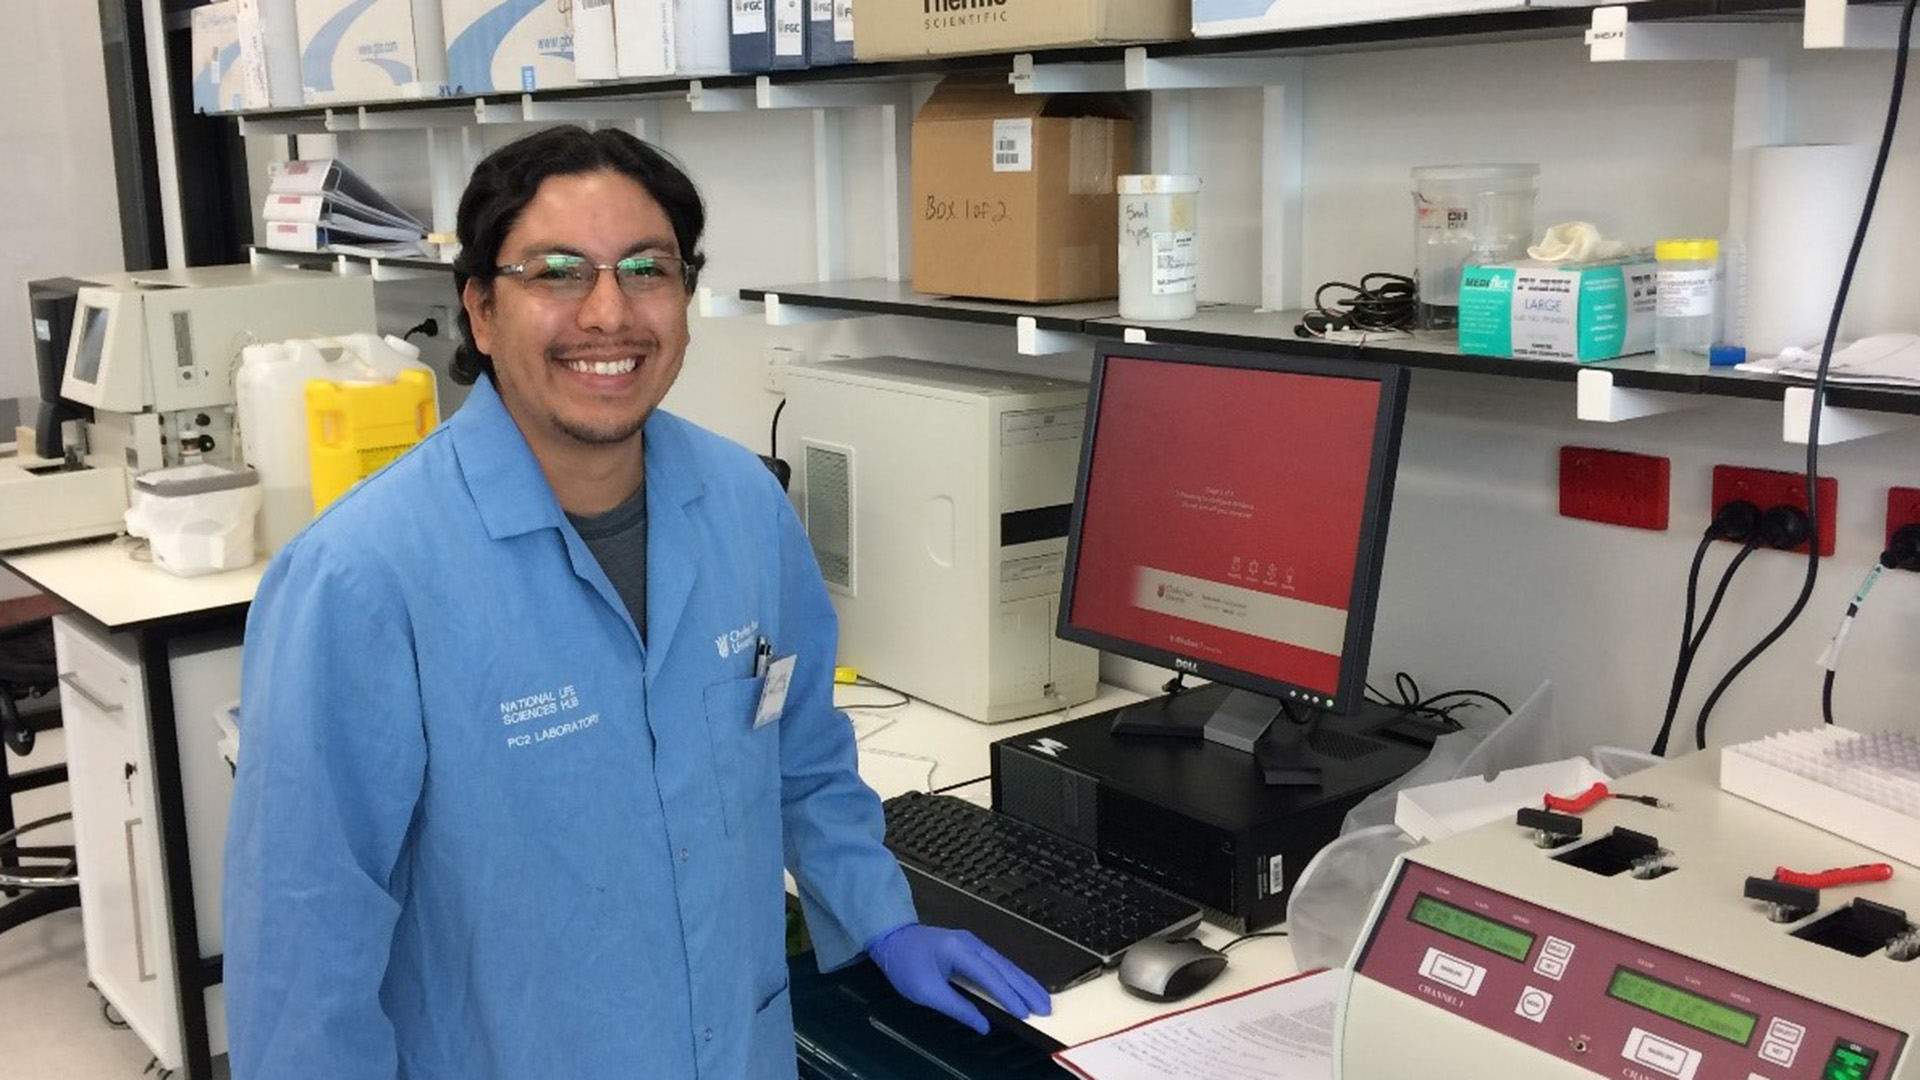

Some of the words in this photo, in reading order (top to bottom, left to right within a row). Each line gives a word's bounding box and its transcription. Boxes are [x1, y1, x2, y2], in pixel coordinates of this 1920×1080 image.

[743, 1, 763, 12] FGC
[784, 23, 801, 33] FGC
[924, 11, 1007, 30] SCIENTIFIC
[926, 194, 956, 221] Box
[974, 202, 990, 219] of
[1524, 298, 1562, 313] LARGE
[1176, 657, 1198, 673] DELL
[500, 691, 556, 713] NATIONAL
[559, 684, 576, 699] LIFE
[503, 702, 558, 725] SCIENCES
[560, 696, 579, 711] HUB
[507, 734, 532, 749] PC2
[1418, 983, 1459, 1006] CHANNEL
